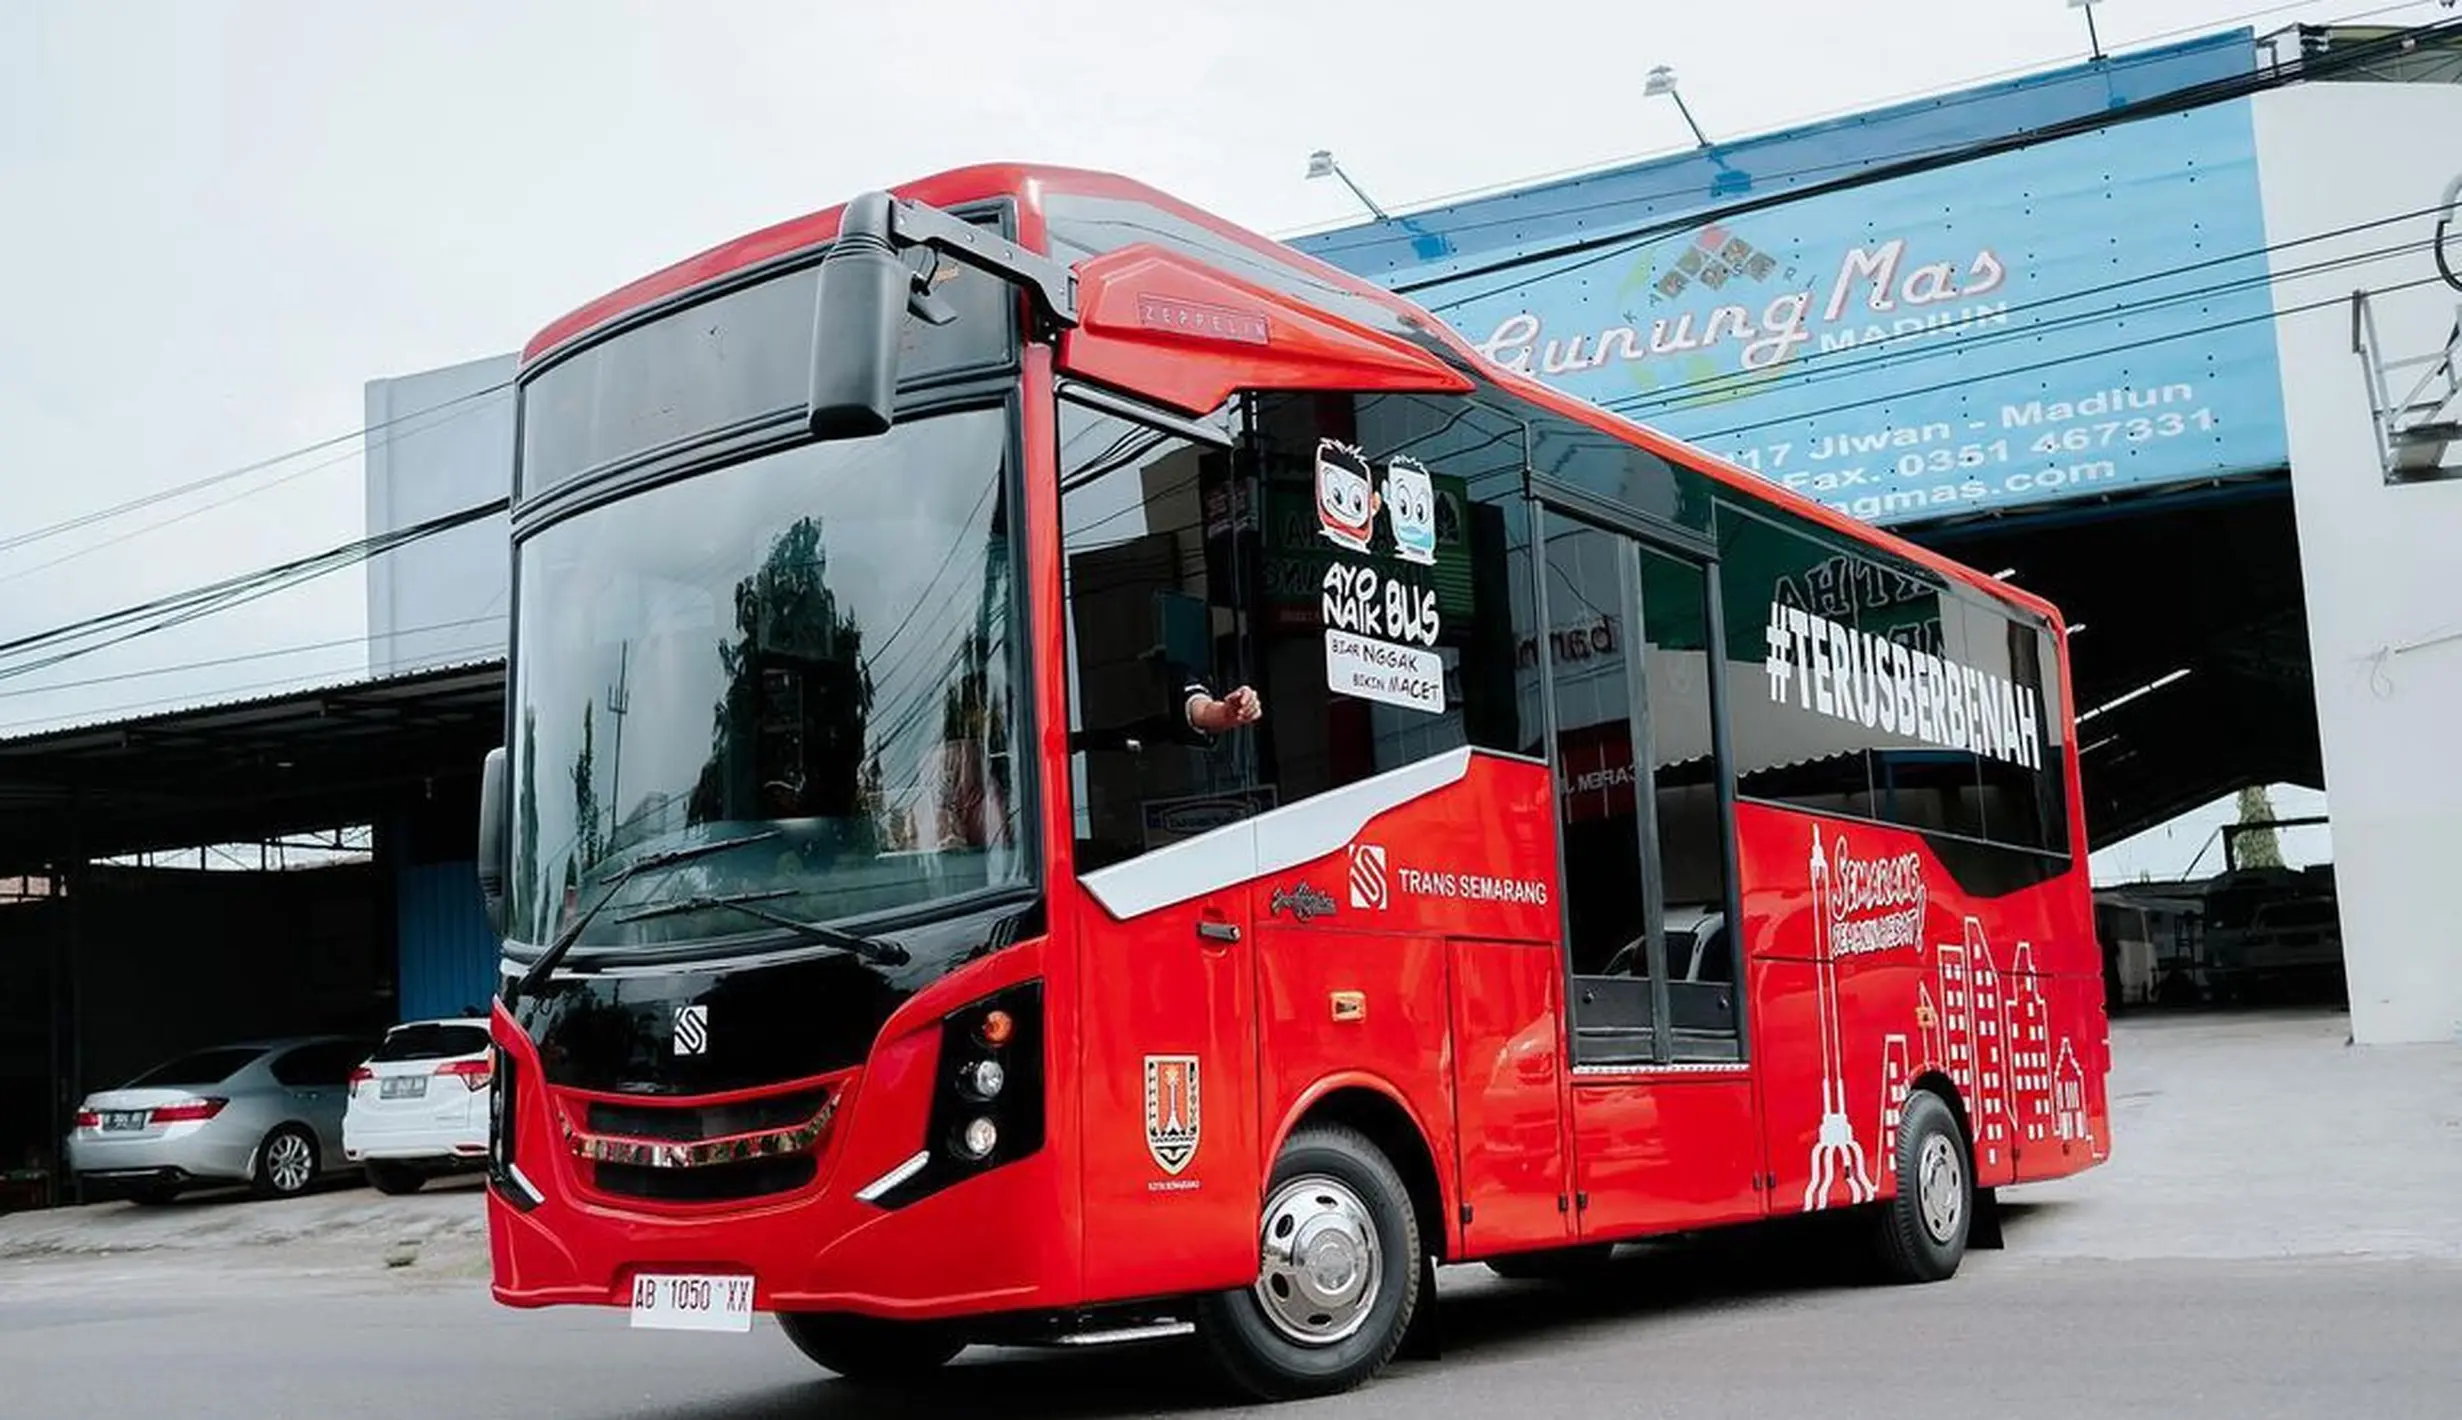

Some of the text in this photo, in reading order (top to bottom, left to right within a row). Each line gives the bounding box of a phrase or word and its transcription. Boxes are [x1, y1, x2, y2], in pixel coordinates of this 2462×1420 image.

[1145, 304, 1266, 338] ZEPPELIN
[1472, 236, 2008, 375] Gunung Mas
[1819, 299, 2010, 352] MADIUN
[1809, 420, 1951, 460] Jiwan
[2000, 382, 2194, 430] Madiun
[1897, 437, 2009, 478] 0351
[2030, 406, 2214, 454] 467331
[1322, 561, 1378, 602] AYO
[1322, 578, 1440, 647] NAIK BUS
[1332, 639, 1419, 673] BIAR NGGAK
[1353, 673, 1440, 701] BIKIN MACET
[1765, 601, 2042, 771] #TERUSBERBENAH
[1398, 867, 1548, 906] TRANS SEMARANG
[635, 1279, 750, 1312] AB 1050 XX
